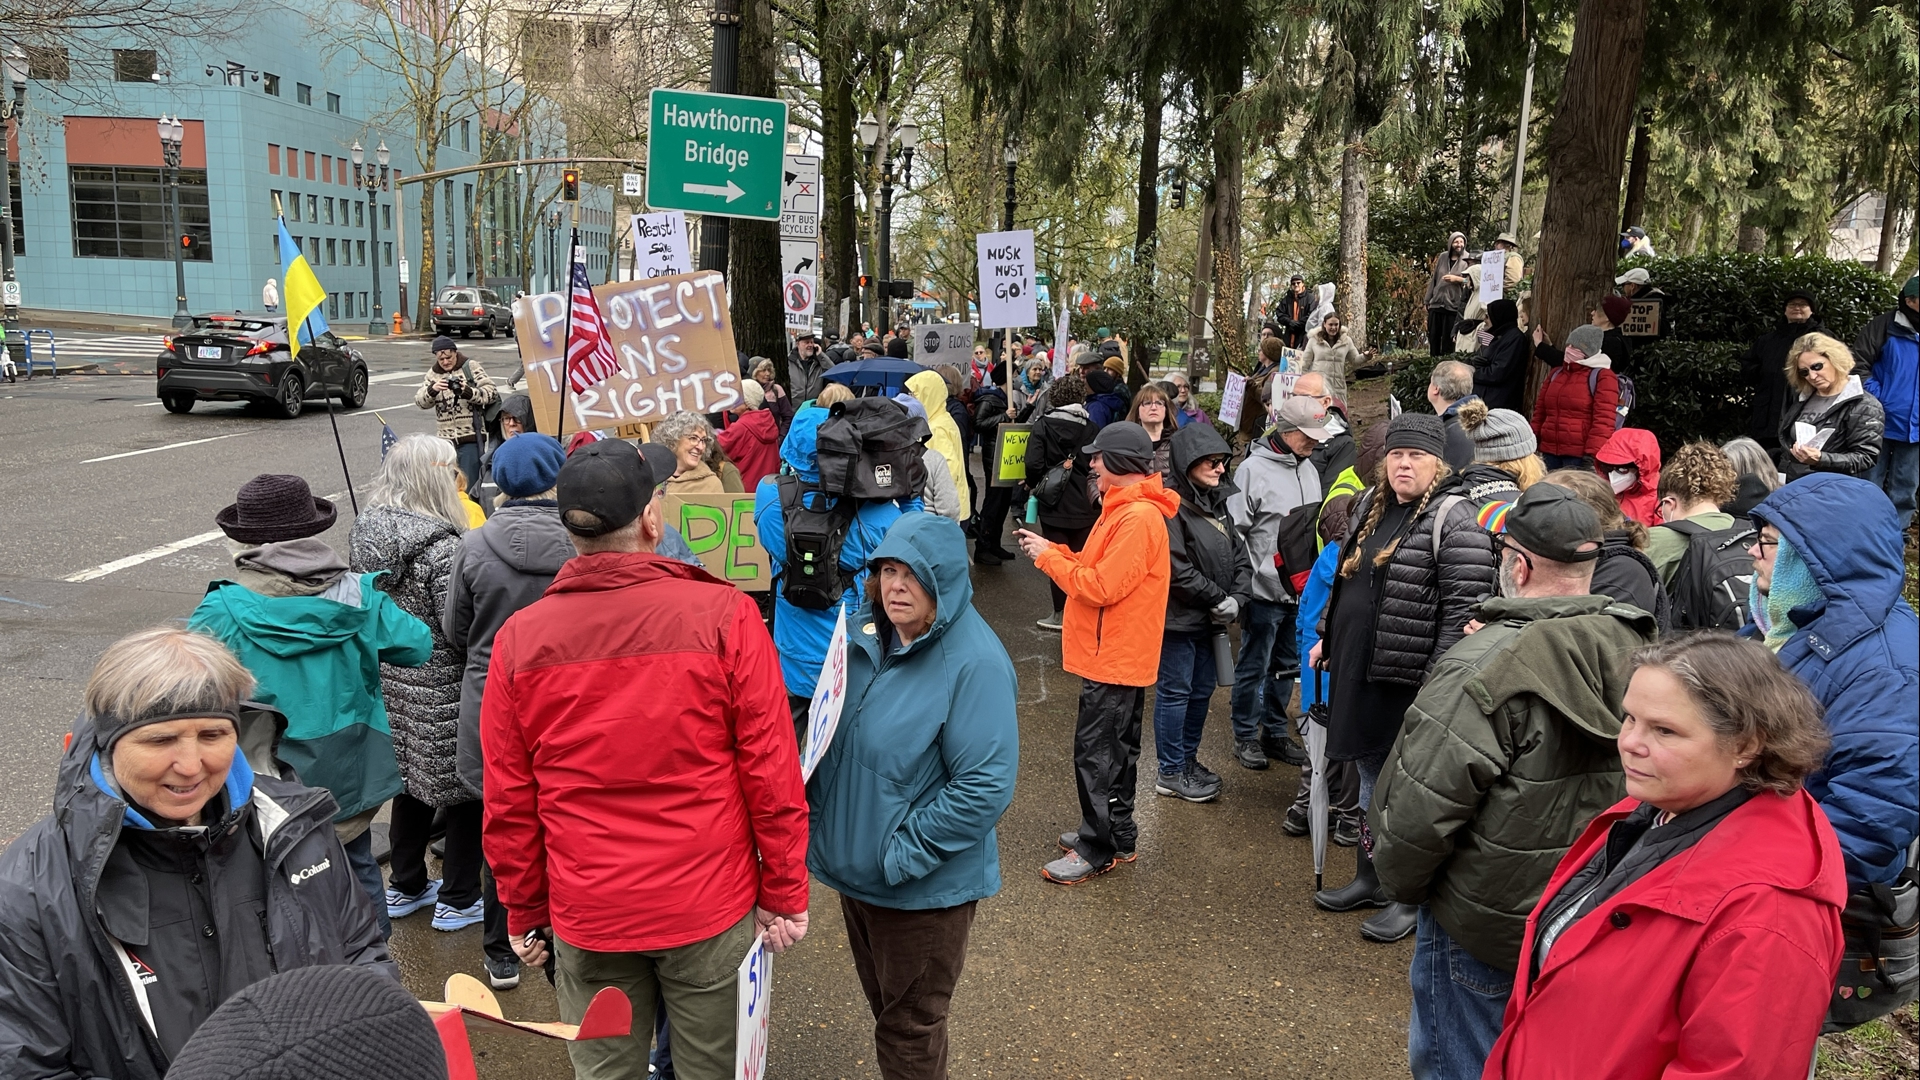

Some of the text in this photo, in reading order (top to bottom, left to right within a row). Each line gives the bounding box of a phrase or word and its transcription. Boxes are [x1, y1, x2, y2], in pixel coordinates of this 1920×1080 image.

[663, 103, 774, 136] Hawthorne
[684, 139, 749, 173] Bridge
[637, 214, 677, 239] Resist!
[781, 214, 815, 225] EPT BUS
[662, 252, 675, 262] our
[987, 245, 1021, 261] MUSK
[995, 264, 1025, 278] MUST
[995, 277, 1028, 304] GO!
[531, 274, 724, 344] POTECT
[1631, 305, 1654, 315] TOP
[924, 338, 940, 347] STOP
[528, 334, 688, 393] TNS
[570, 370, 742, 429] RIGHTS
[1005, 434, 1018, 445] WE
[1003, 454, 1015, 466] WE
